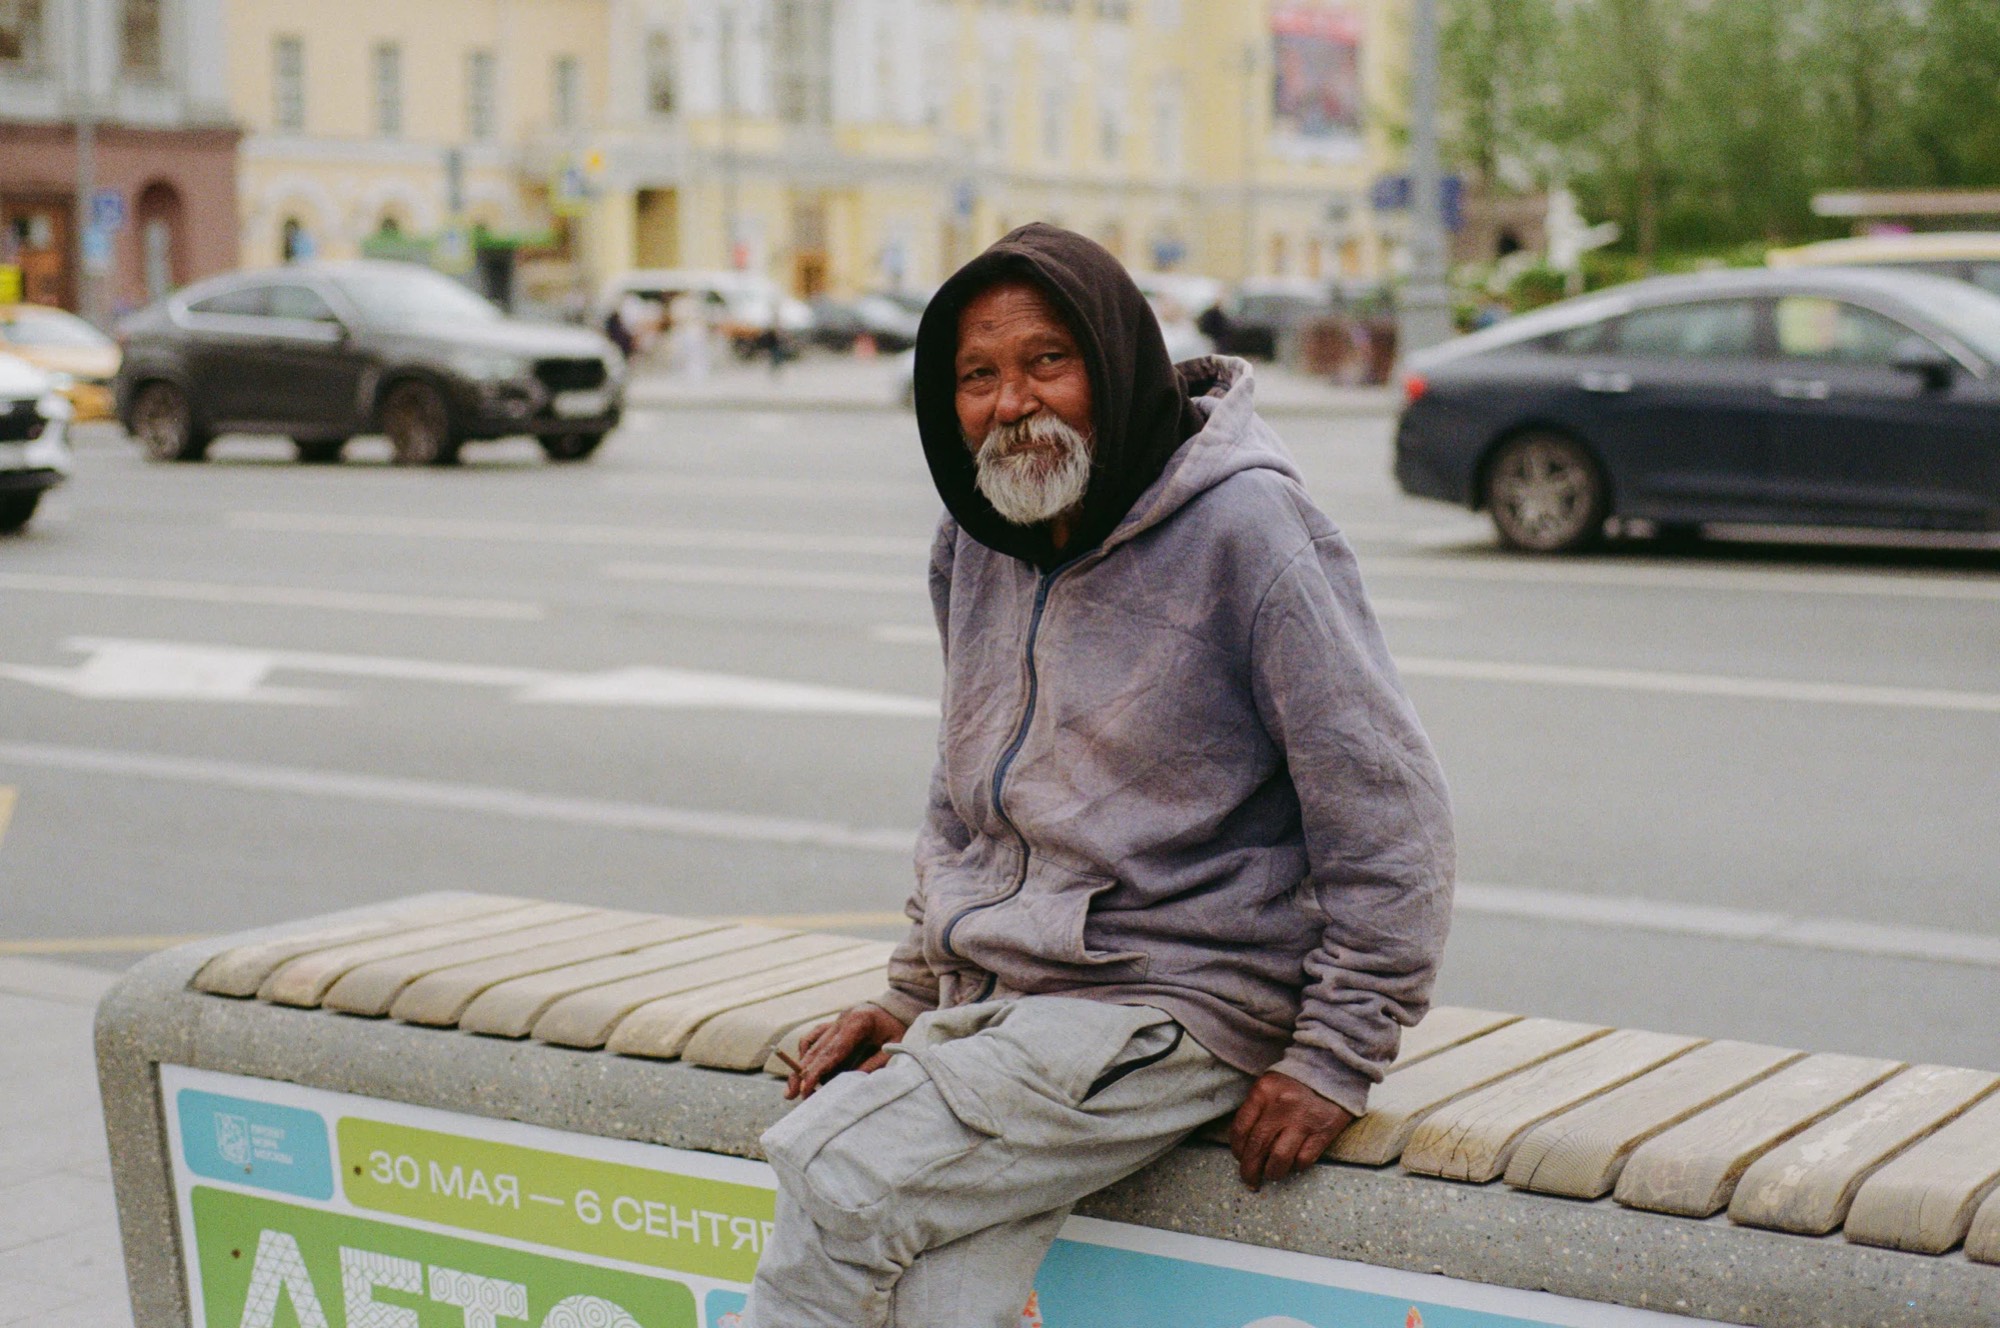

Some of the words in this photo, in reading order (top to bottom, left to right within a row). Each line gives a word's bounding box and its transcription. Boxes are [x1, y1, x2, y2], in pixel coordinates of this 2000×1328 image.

[368, 1150, 420, 1189] 30
[429, 1160, 520, 1210] МАЯ
[575, 1189, 601, 1225] 6
